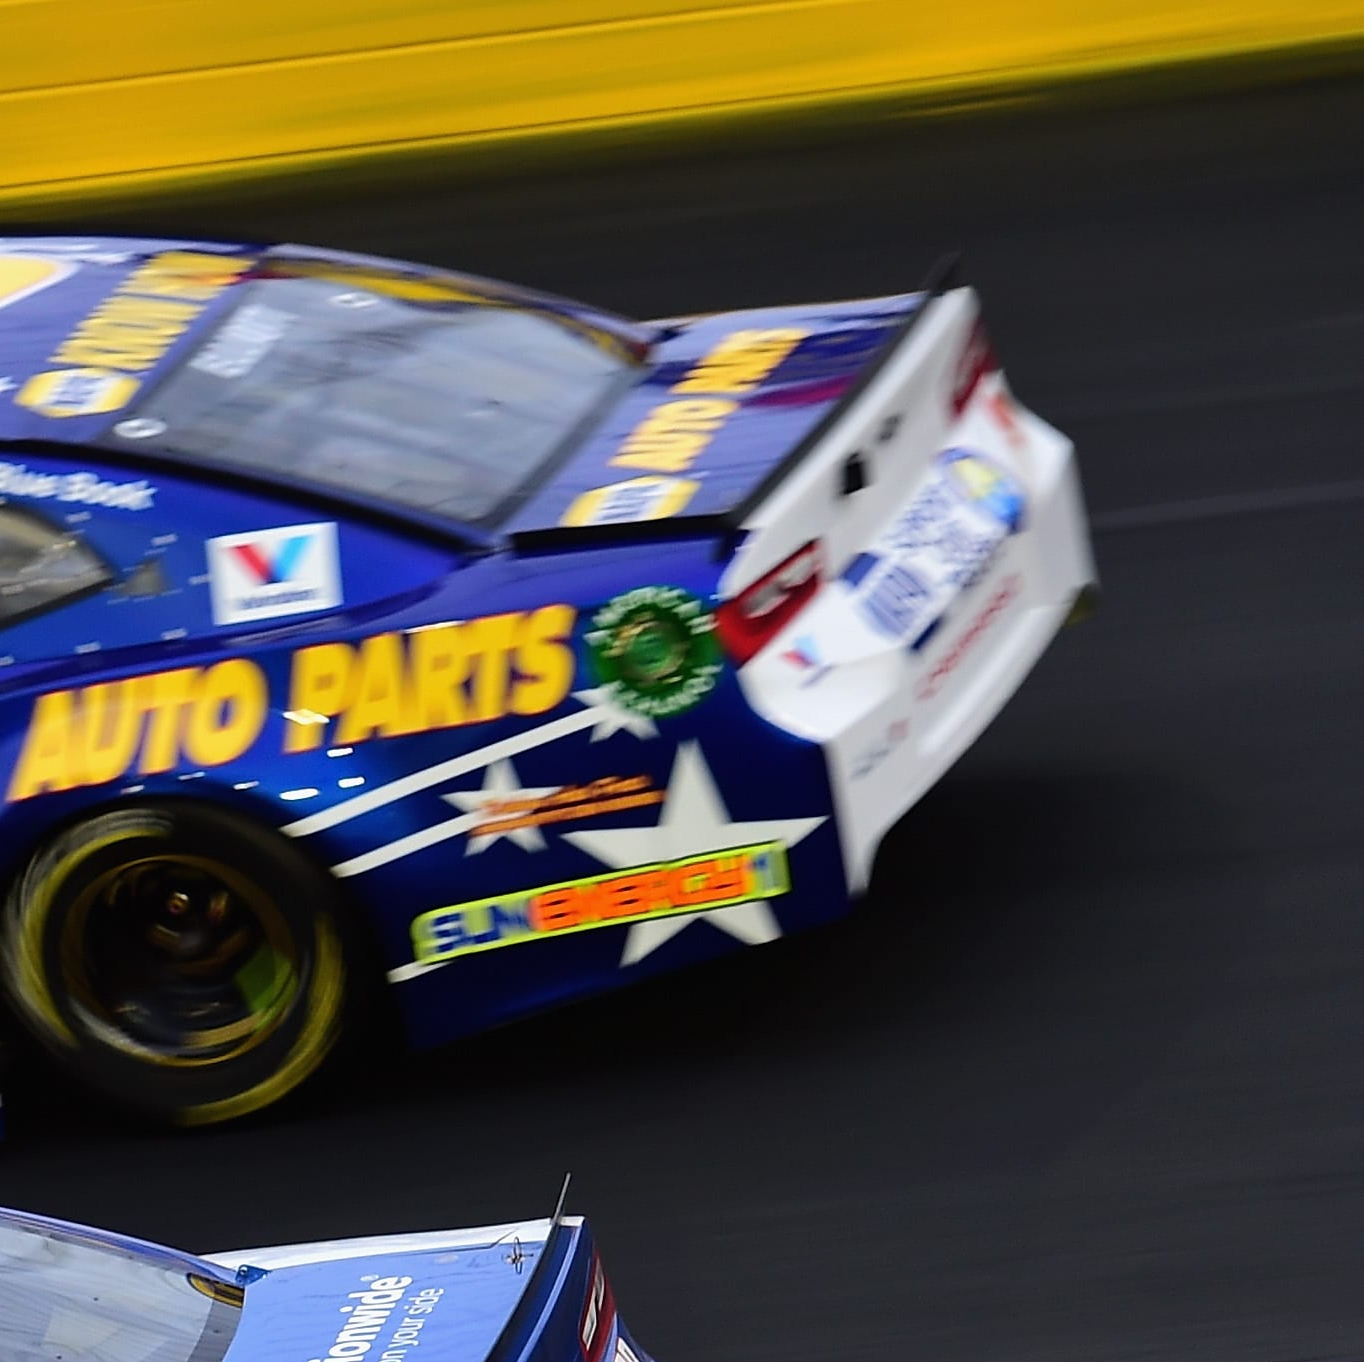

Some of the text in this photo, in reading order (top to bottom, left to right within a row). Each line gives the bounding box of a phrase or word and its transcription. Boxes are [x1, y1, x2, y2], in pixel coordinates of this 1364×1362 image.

[6, 603, 577, 804] AUTO PARTS
[404, 1288, 445, 1315] side
[388, 1317, 426, 1347] your
